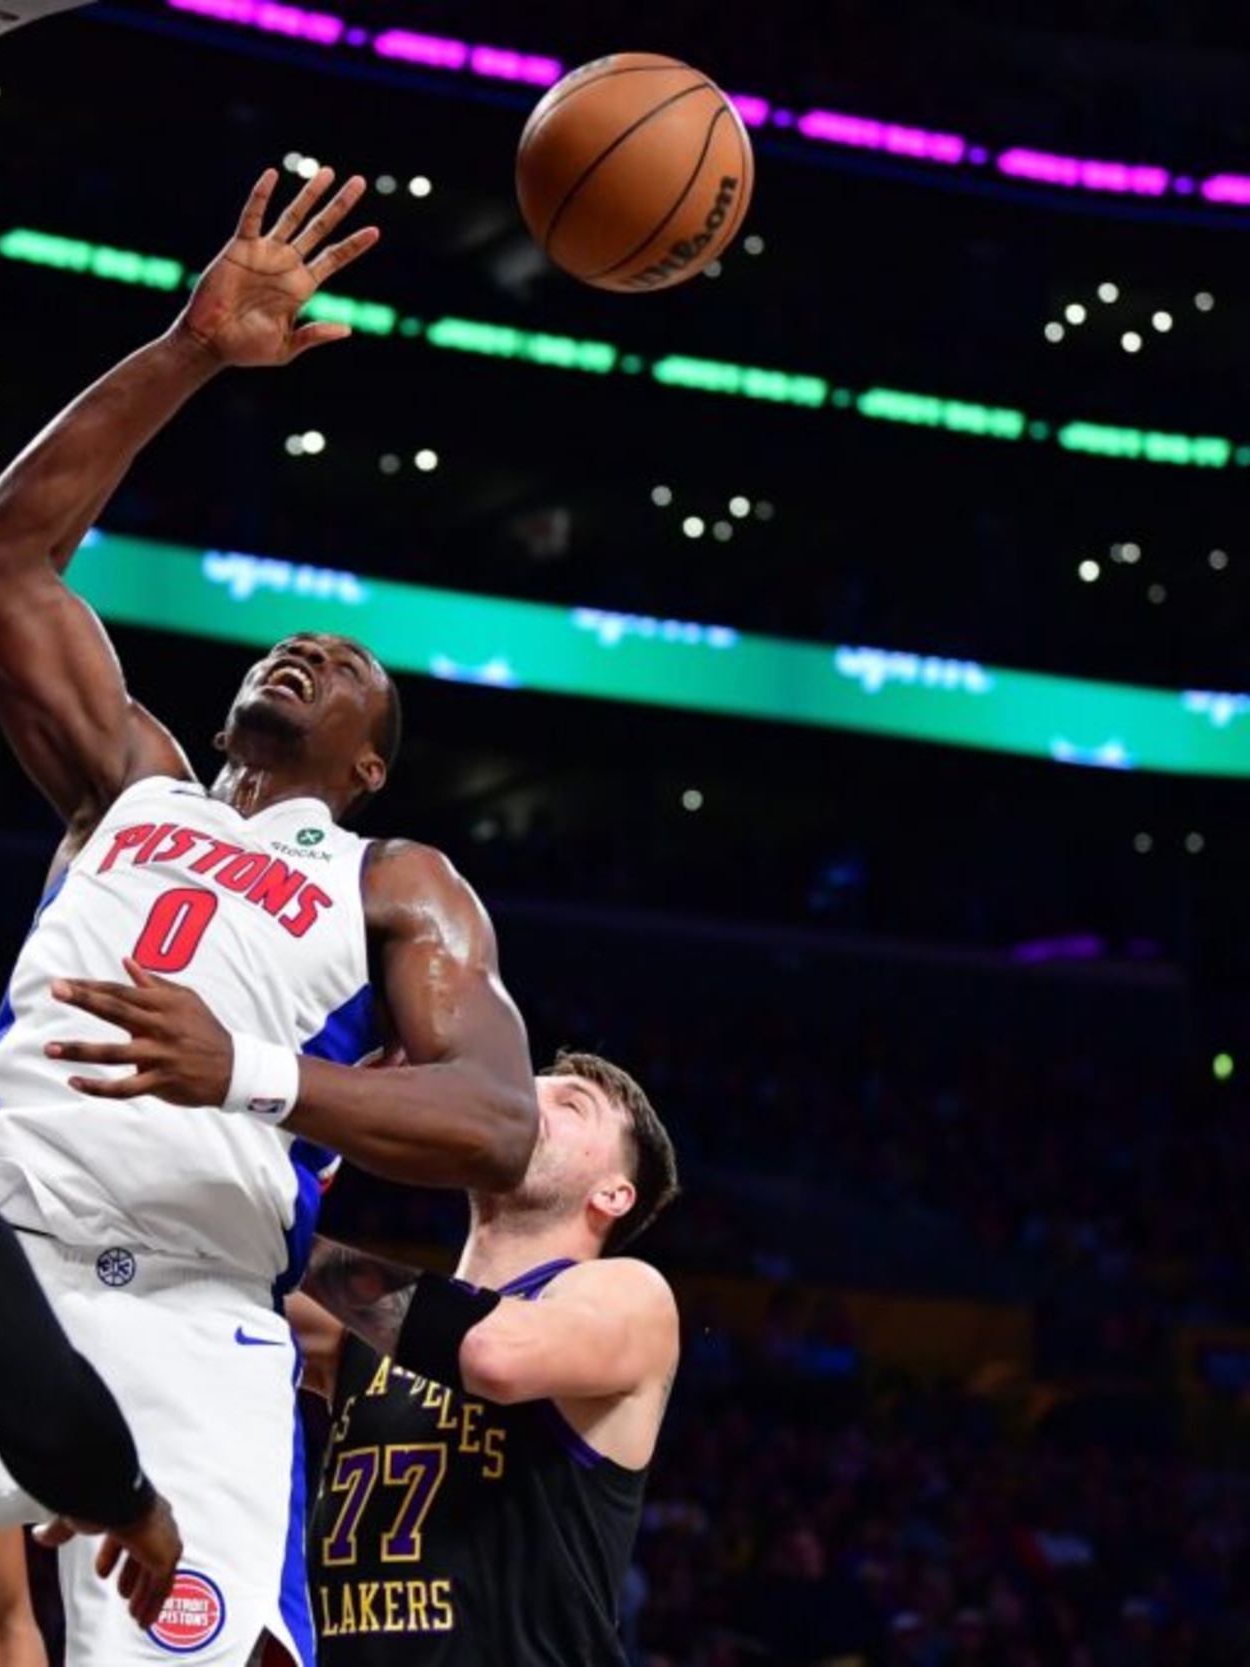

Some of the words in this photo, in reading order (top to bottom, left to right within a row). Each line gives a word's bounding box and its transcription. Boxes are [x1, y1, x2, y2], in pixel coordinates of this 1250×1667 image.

[98, 822, 334, 938] PISTONS
[131, 887, 219, 973] 0
[365, 1354, 507, 1479] AELES
[323, 1442, 448, 1566] 77
[320, 1580, 454, 1637] LAKERS
